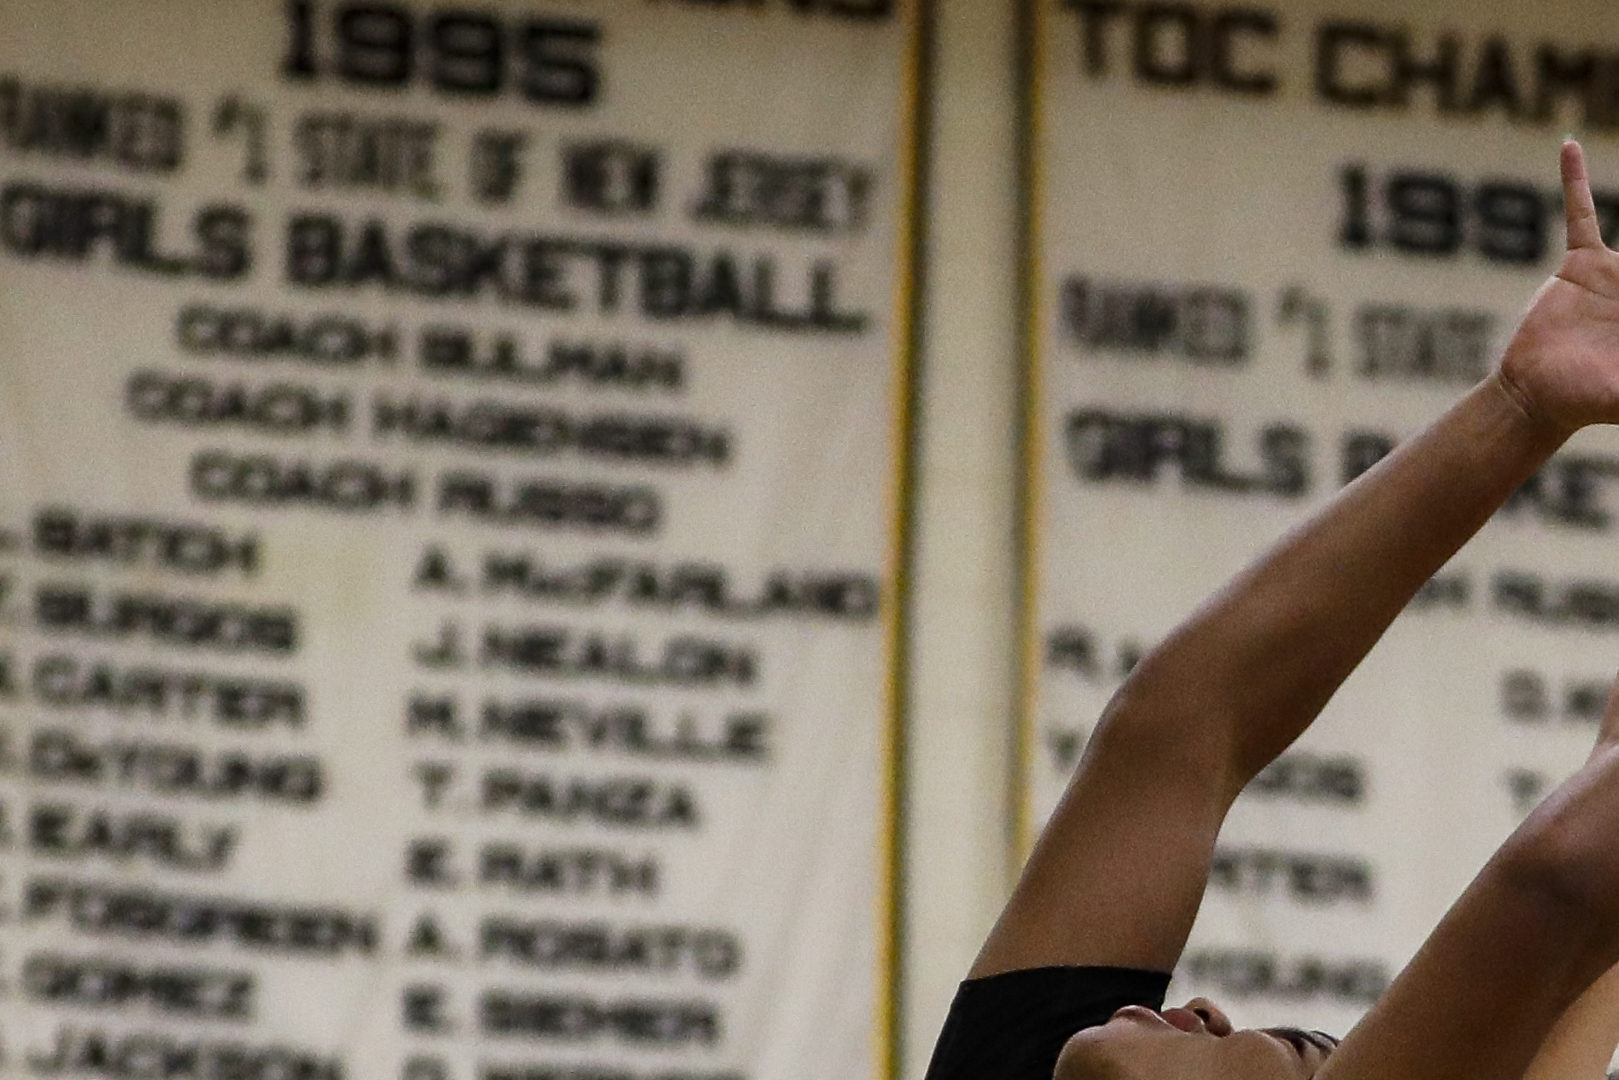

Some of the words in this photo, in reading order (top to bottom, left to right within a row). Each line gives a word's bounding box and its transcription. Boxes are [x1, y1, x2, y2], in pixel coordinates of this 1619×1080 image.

[282, 3, 600, 103] 1995
[1076, 5, 1277, 92] TOC
[0, 184, 250, 277] GIRLS
[288, 213, 869, 331] BASKETBALL
[176, 305, 395, 362] COACH
[126, 370, 350, 437] COACH
[1065, 412, 1308, 493] GIRLS
[189, 450, 415, 509] COACH
[437, 470, 662, 535] RUSSO
[478, 627, 758, 688] NEALON
[32, 658, 307, 728] CARTER
[478, 699, 771, 762] NEVILLE
[28, 804, 239, 869] EARLY
[476, 844, 659, 897] RATH
